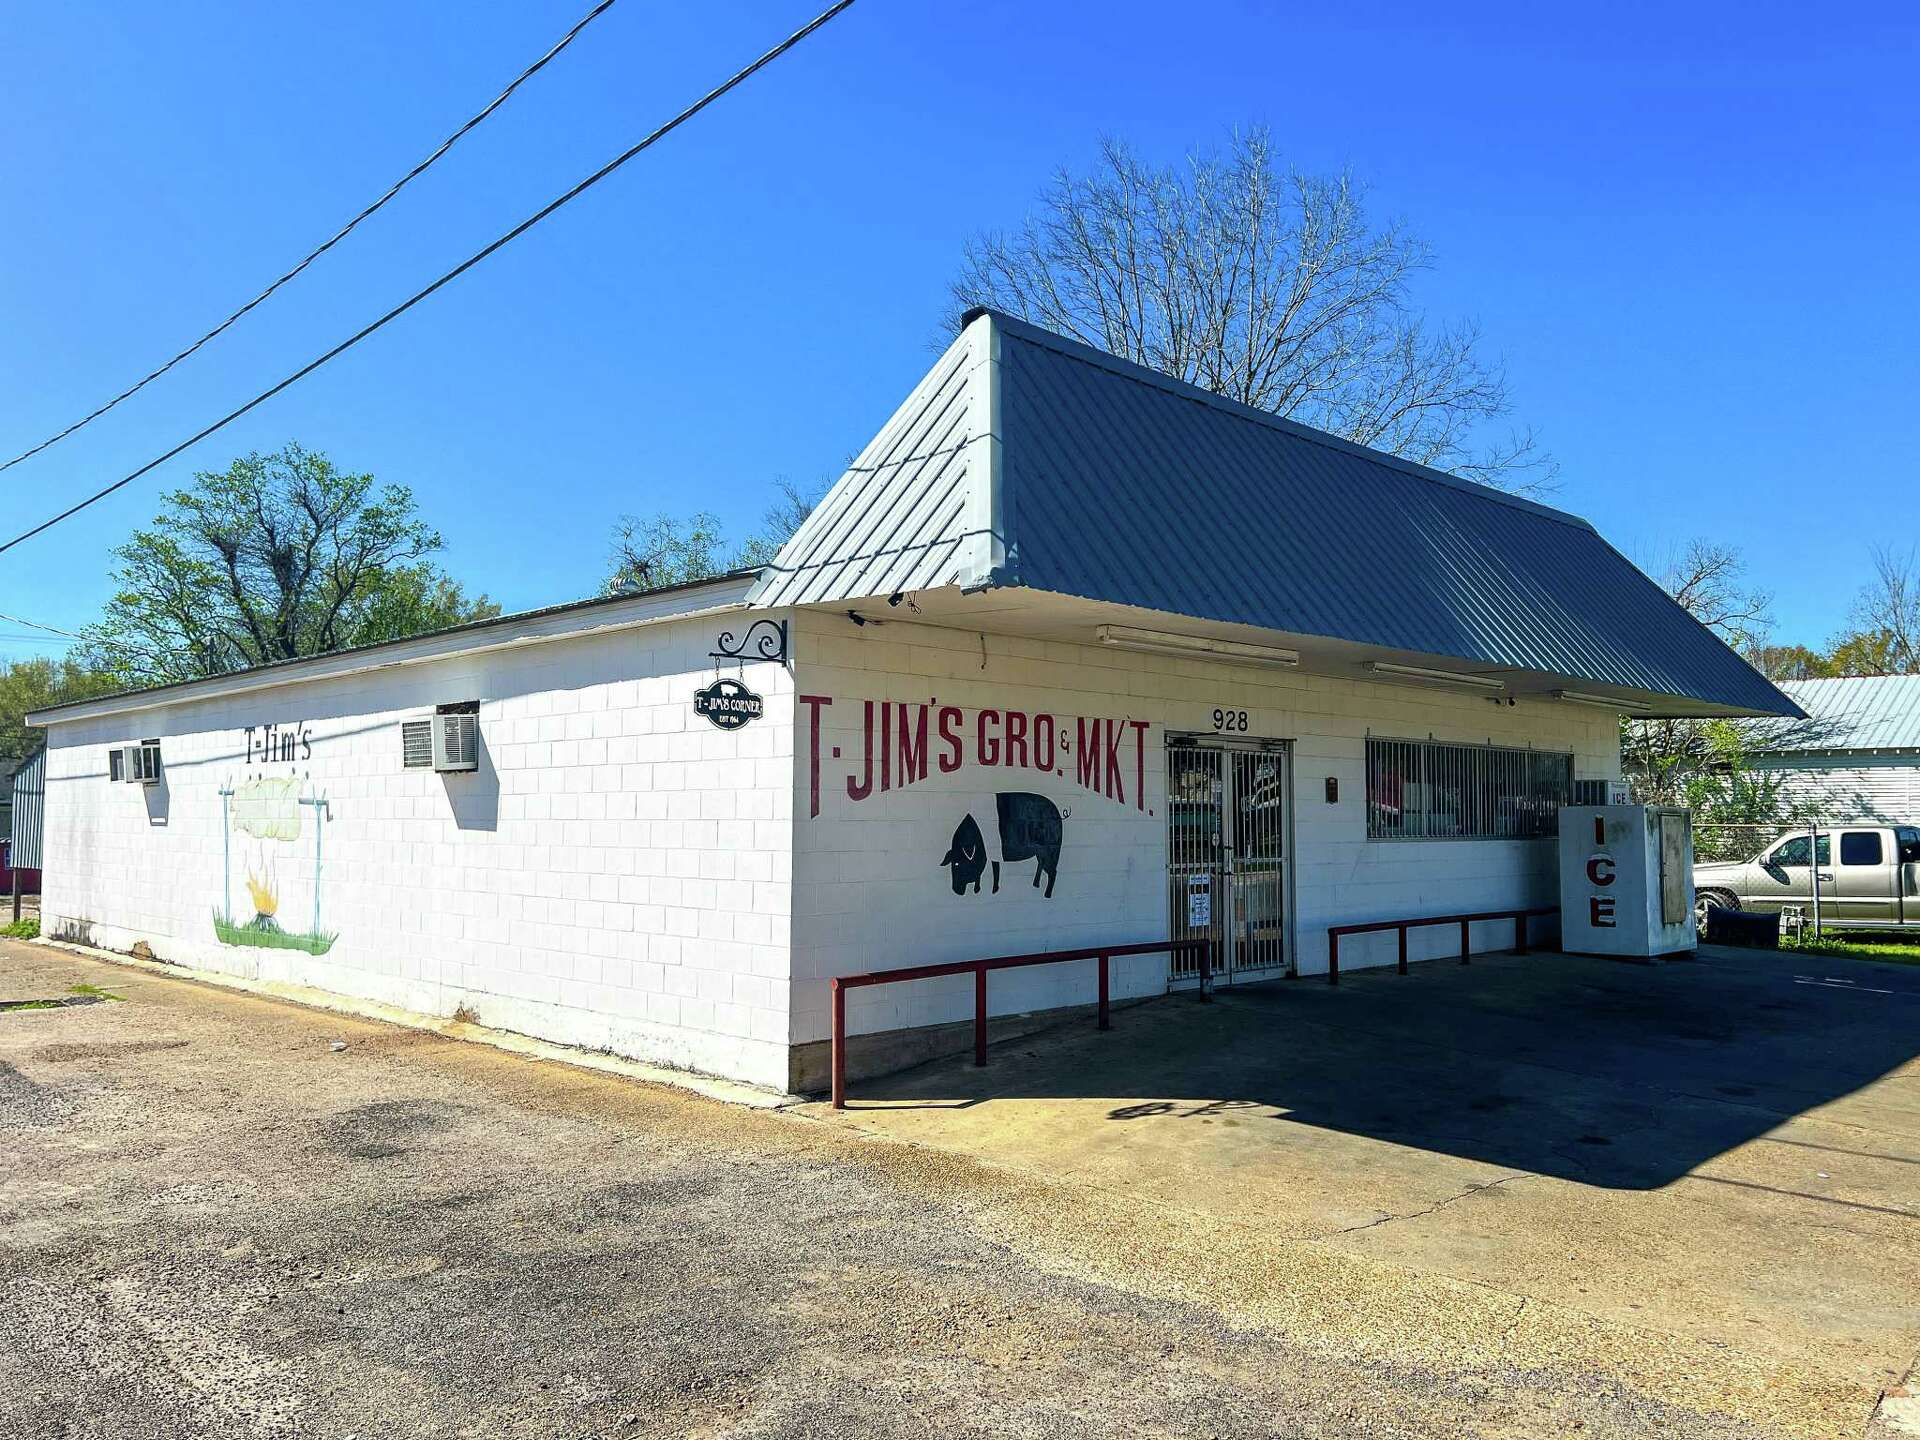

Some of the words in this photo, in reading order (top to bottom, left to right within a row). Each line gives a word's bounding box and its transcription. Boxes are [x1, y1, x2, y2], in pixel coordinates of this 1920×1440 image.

[697, 697, 730, 711] T-JIM'S
[731, 700, 760, 713] CORNER
[1213, 708, 1248, 732] 928
[977, 706, 1063, 777] GRO.
[1060, 729, 1070, 755] &
[1612, 792, 1626, 805] ICE
[1586, 815, 1617, 928] ICE
